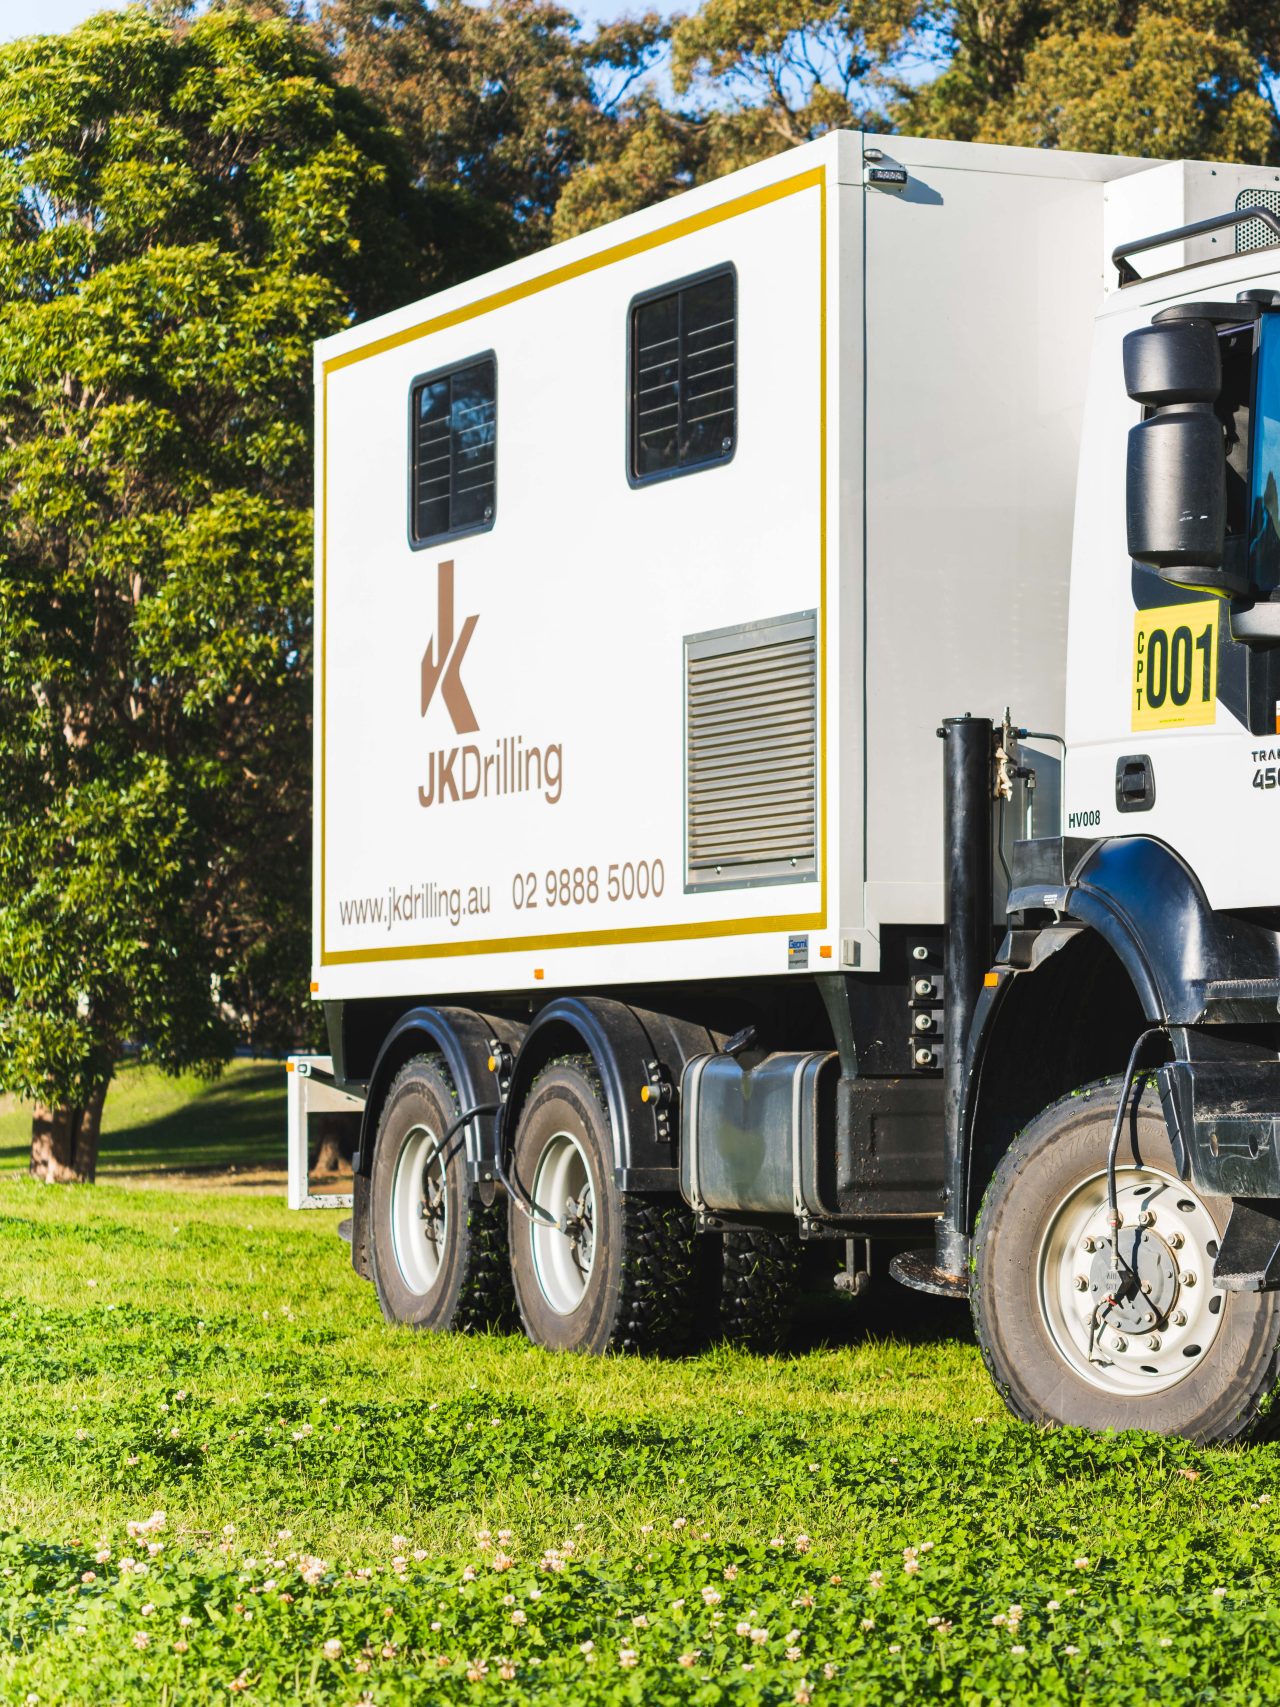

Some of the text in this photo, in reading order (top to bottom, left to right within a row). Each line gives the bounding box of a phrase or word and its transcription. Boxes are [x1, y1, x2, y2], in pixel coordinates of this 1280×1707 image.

[1146, 623, 1213, 709] 001
[418, 735, 563, 808] JKDrilling
[1068, 809, 1101, 829] HV008
[339, 859, 665, 931] www.jkdrilling.au 02 9888 5000
